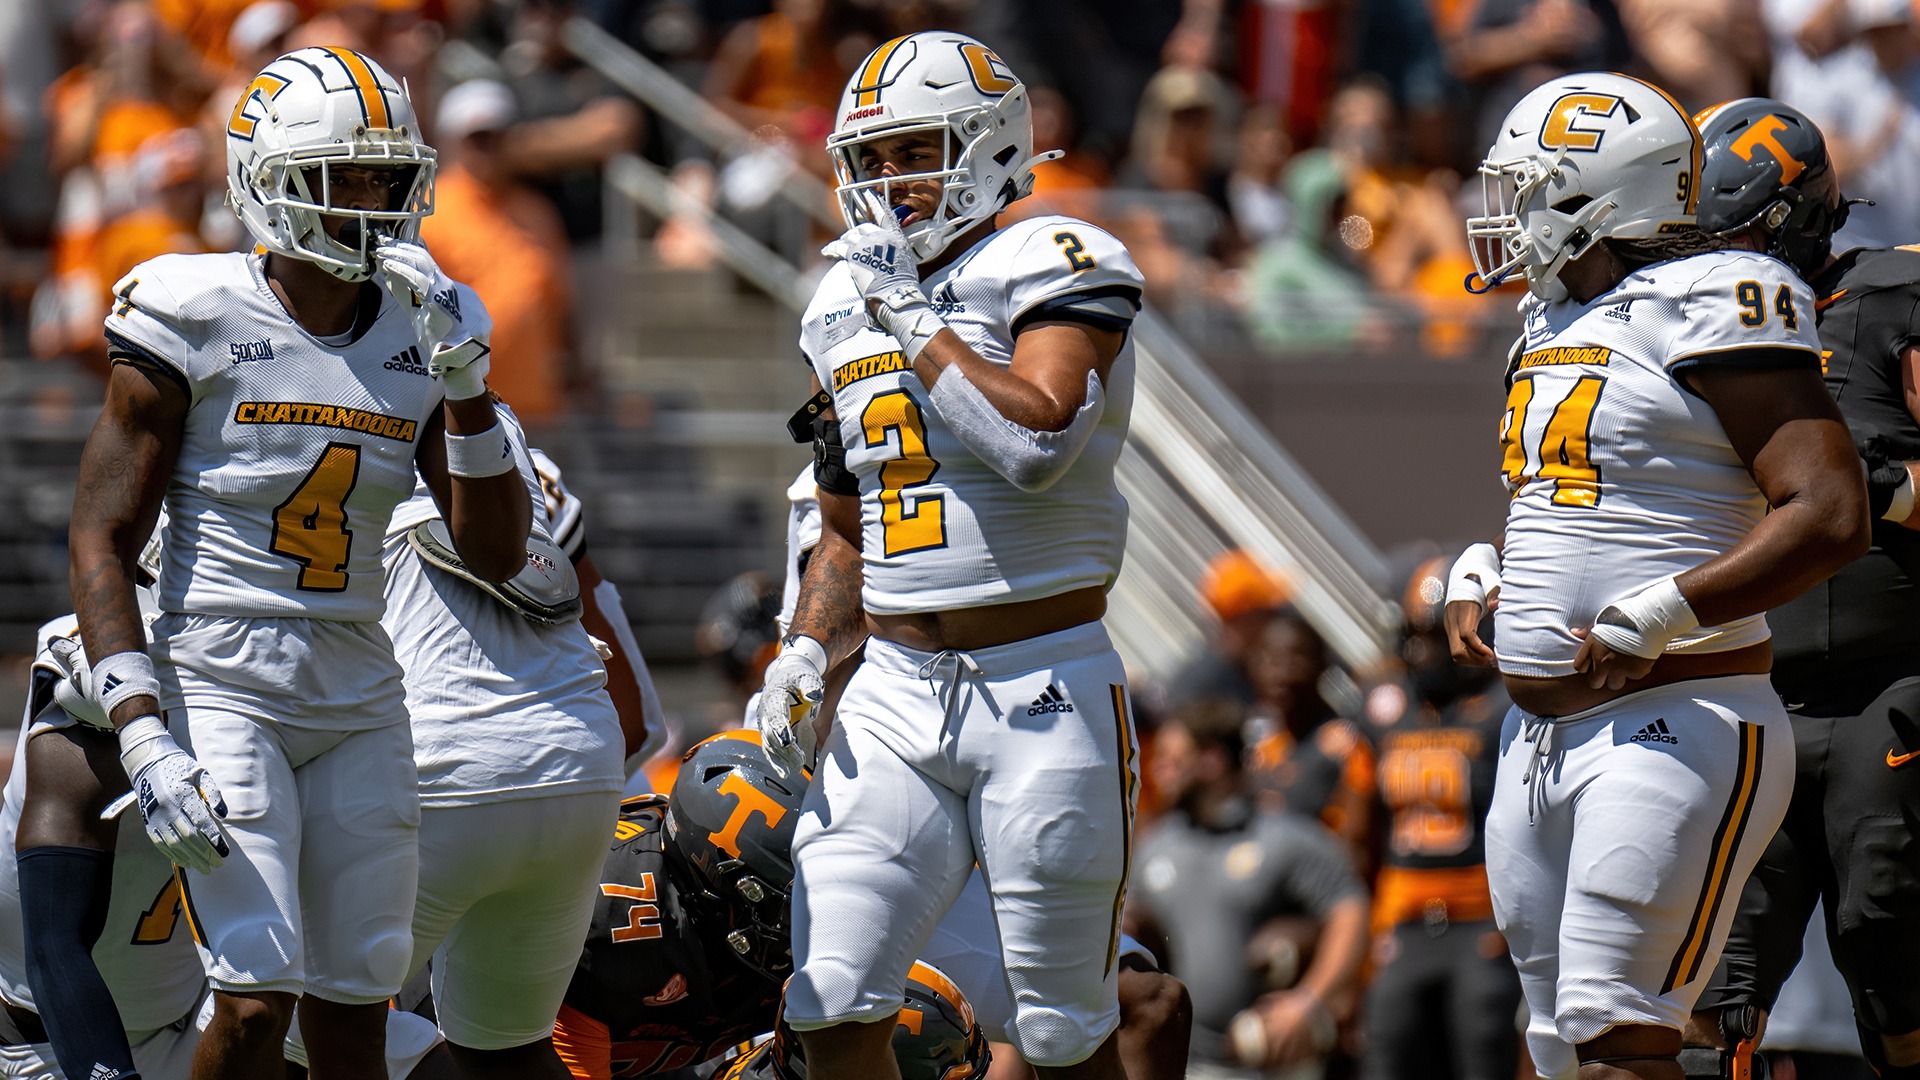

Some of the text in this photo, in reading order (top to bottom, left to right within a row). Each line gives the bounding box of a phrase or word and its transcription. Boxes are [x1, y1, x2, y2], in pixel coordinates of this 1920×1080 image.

[958, 43, 1019, 97] C
[227, 72, 293, 142] C
[1538, 92, 1624, 153] C
[1730, 114, 1806, 186] T
[851, 251, 897, 276] adidas
[1053, 231, 1097, 274] 2
[1735, 280, 1798, 331] 94
[230, 338, 275, 365] SOCON
[383, 360, 429, 377] adidas
[833, 350, 913, 393] CHATTAN
[1519, 346, 1611, 369] HATTANOOGA
[235, 402, 417, 442] CHATTANOOGA
[860, 386, 949, 559] 2
[269, 441, 361, 592] 4
[1027, 702, 1074, 717] adidas
[1630, 732, 1678, 745] adidas
[708, 772, 787, 859] T
[600, 872, 663, 944] 74
